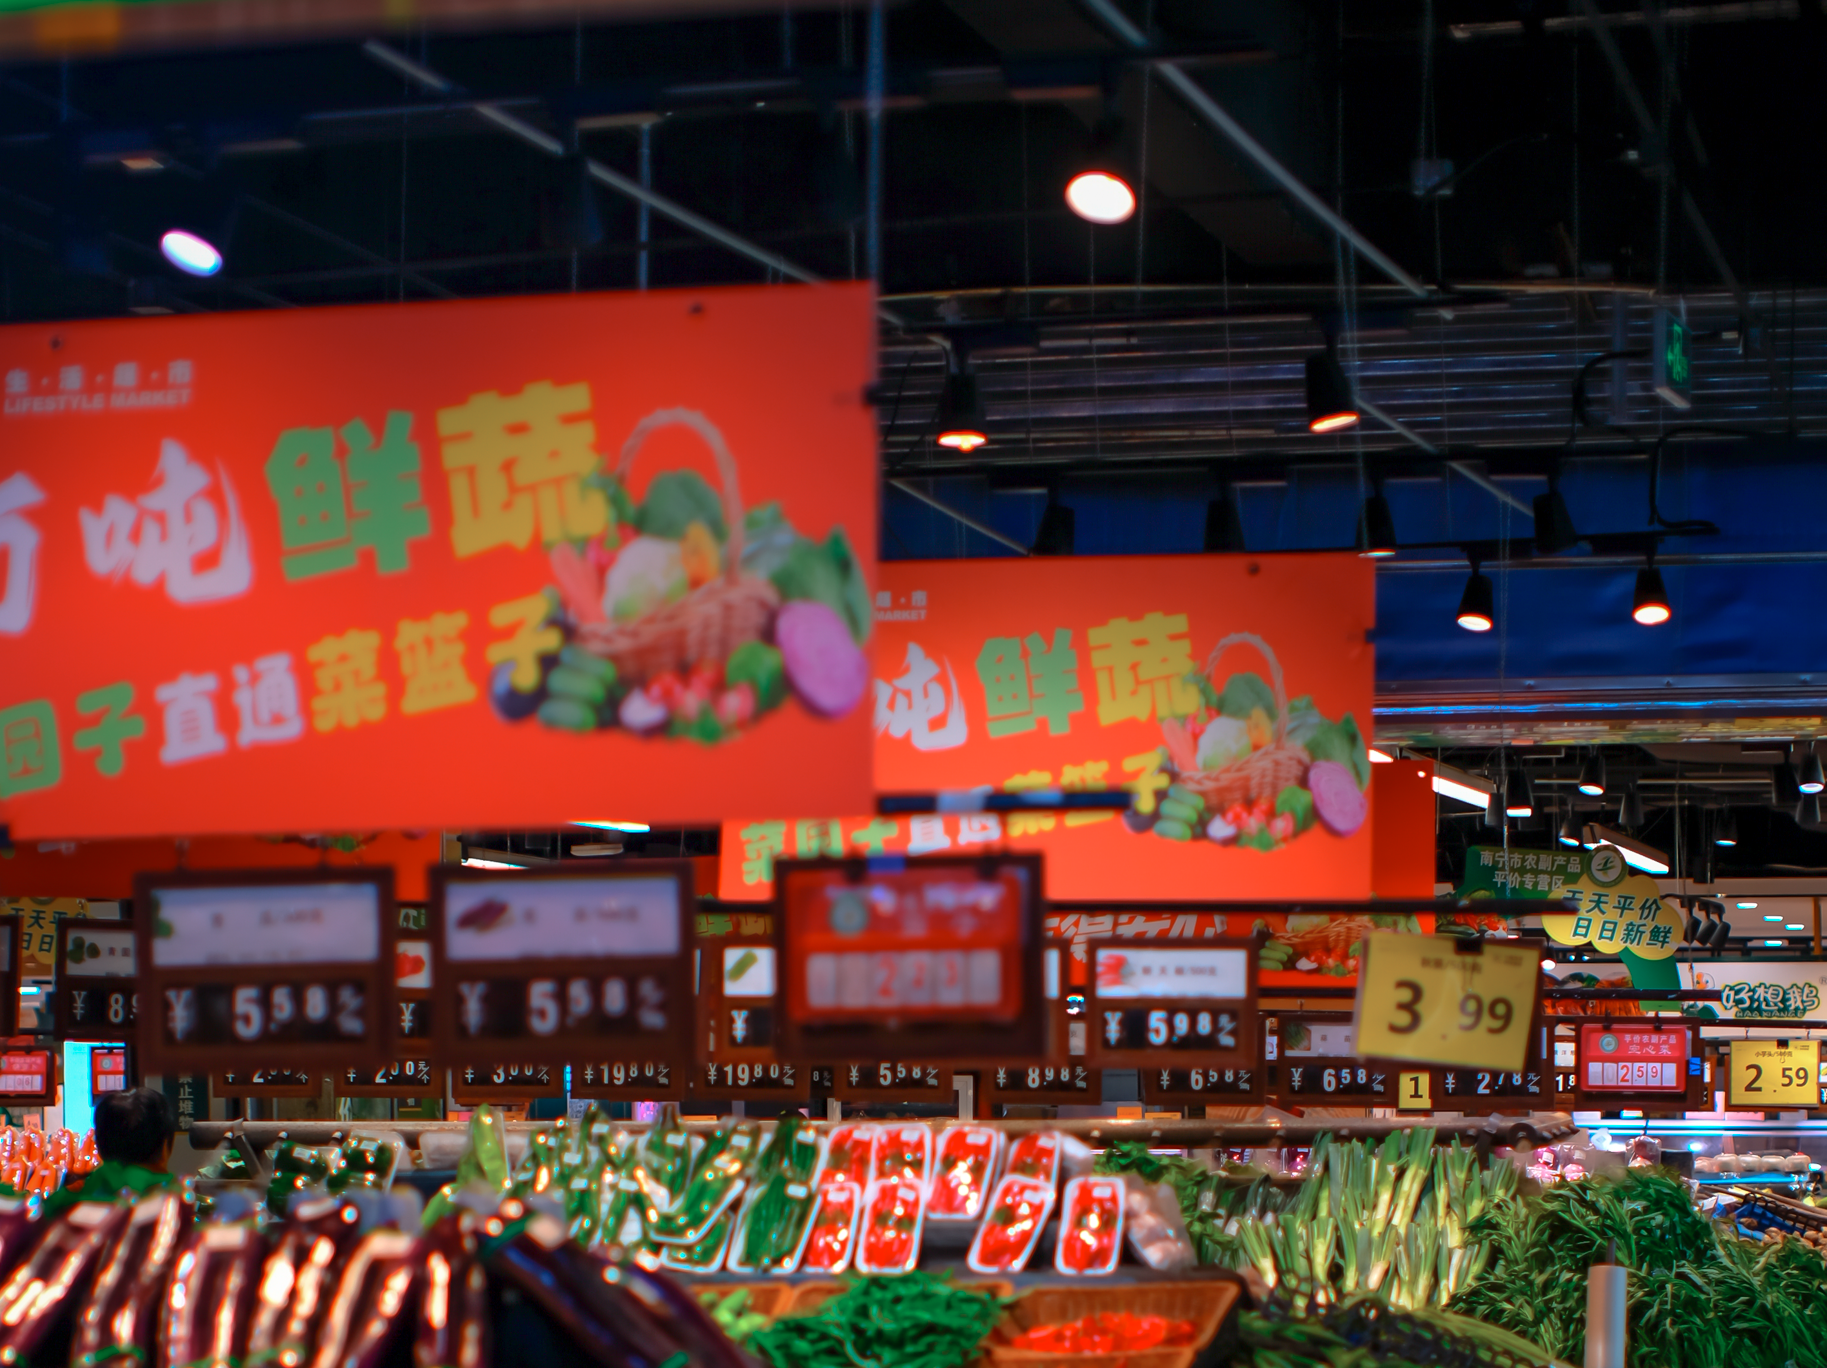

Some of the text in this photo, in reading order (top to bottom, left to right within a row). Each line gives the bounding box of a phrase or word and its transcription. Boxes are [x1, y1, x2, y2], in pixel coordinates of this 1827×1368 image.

[110, 388, 191, 408] MARKET
[1480, 850, 1581, 873] 南宁市农副产品
[1493, 871, 1565, 891] 平价专营区
[1571, 915, 1673, 949] 日日新鲜
[1722, 983, 1819, 1011] 好想鹅
[1387, 979, 1514, 1041] 3.99
[1148, 1010, 1212, 1046] 5.98
[599, 1063, 655, 1086] 19.80
[723, 1063, 780, 1086] 19.80
[879, 1063, 921, 1086] 5.58
[1027, 1066, 1070, 1089] 8.98
[1190, 1068, 1234, 1091] 6.58
[1322, 1068, 1367, 1092] 6.58
[1744, 1063, 1809, 1093] 2.59
[1409, 1075, 1423, 1099] 1
